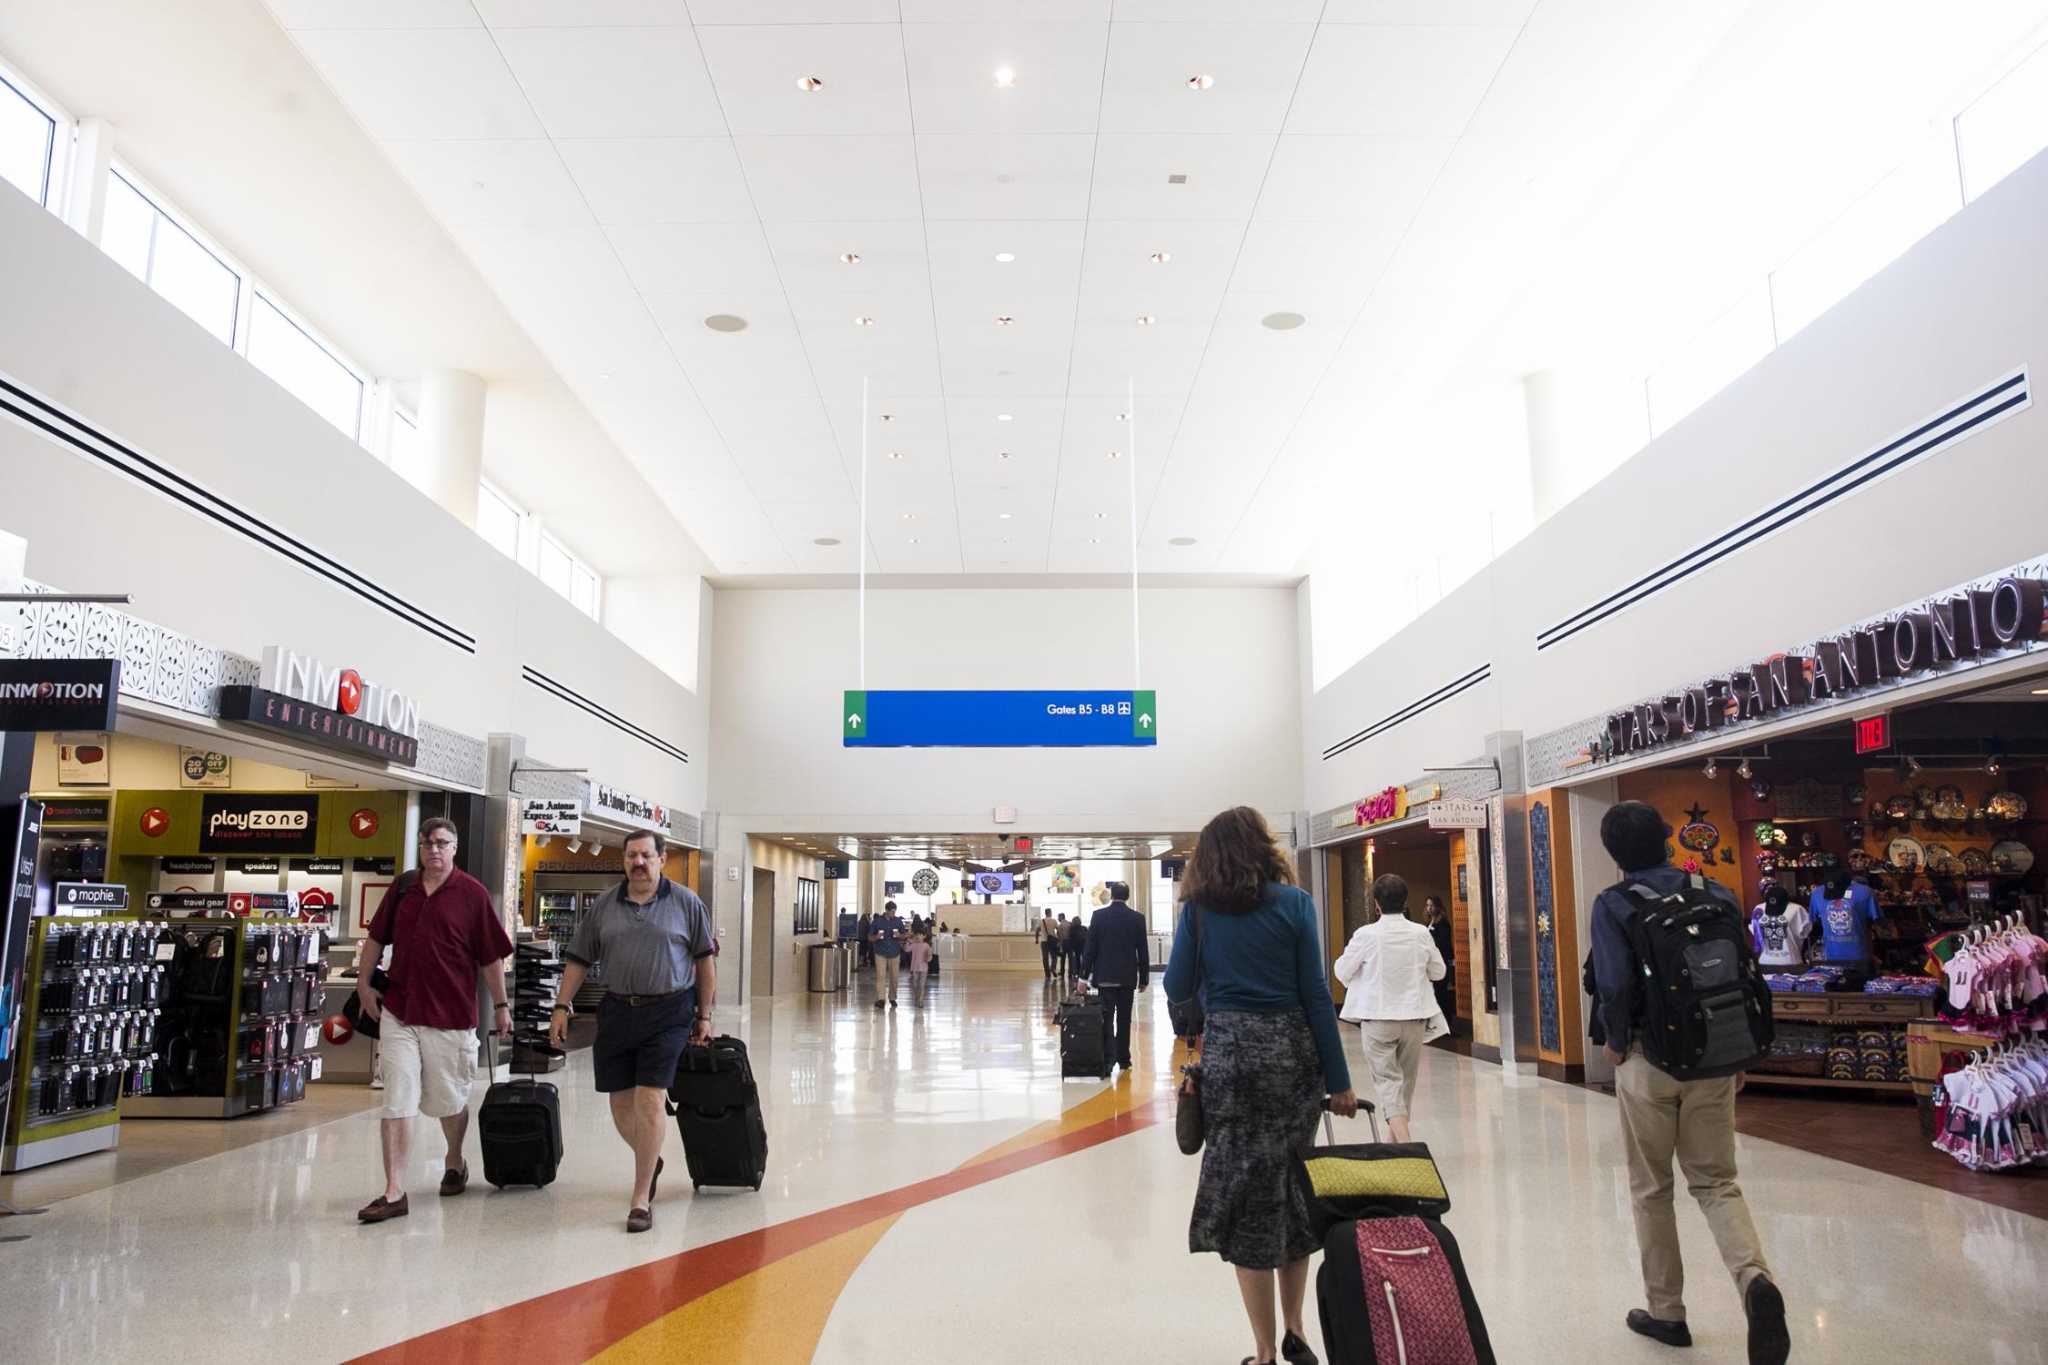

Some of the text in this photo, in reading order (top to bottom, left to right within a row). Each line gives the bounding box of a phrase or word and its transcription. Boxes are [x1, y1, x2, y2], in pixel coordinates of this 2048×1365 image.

[1607, 576, 2024, 757] STARS OF SAN ANTONIO
[262, 647, 419, 739] INMOTION
[1047, 703, 1076, 715] Gates
[1079, 704, 1092, 714] B5
[1101, 704, 1115, 714] B8
[266, 698, 412, 759] ENTERTAINMENT
[528, 801, 575, 810] San Antonio
[169, 861, 212, 872] headphones
[244, 863, 278, 871] speakers
[309, 863, 341, 871] cameras
[79, 889, 114, 903] mophie
[183, 898, 224, 908] travel gear
